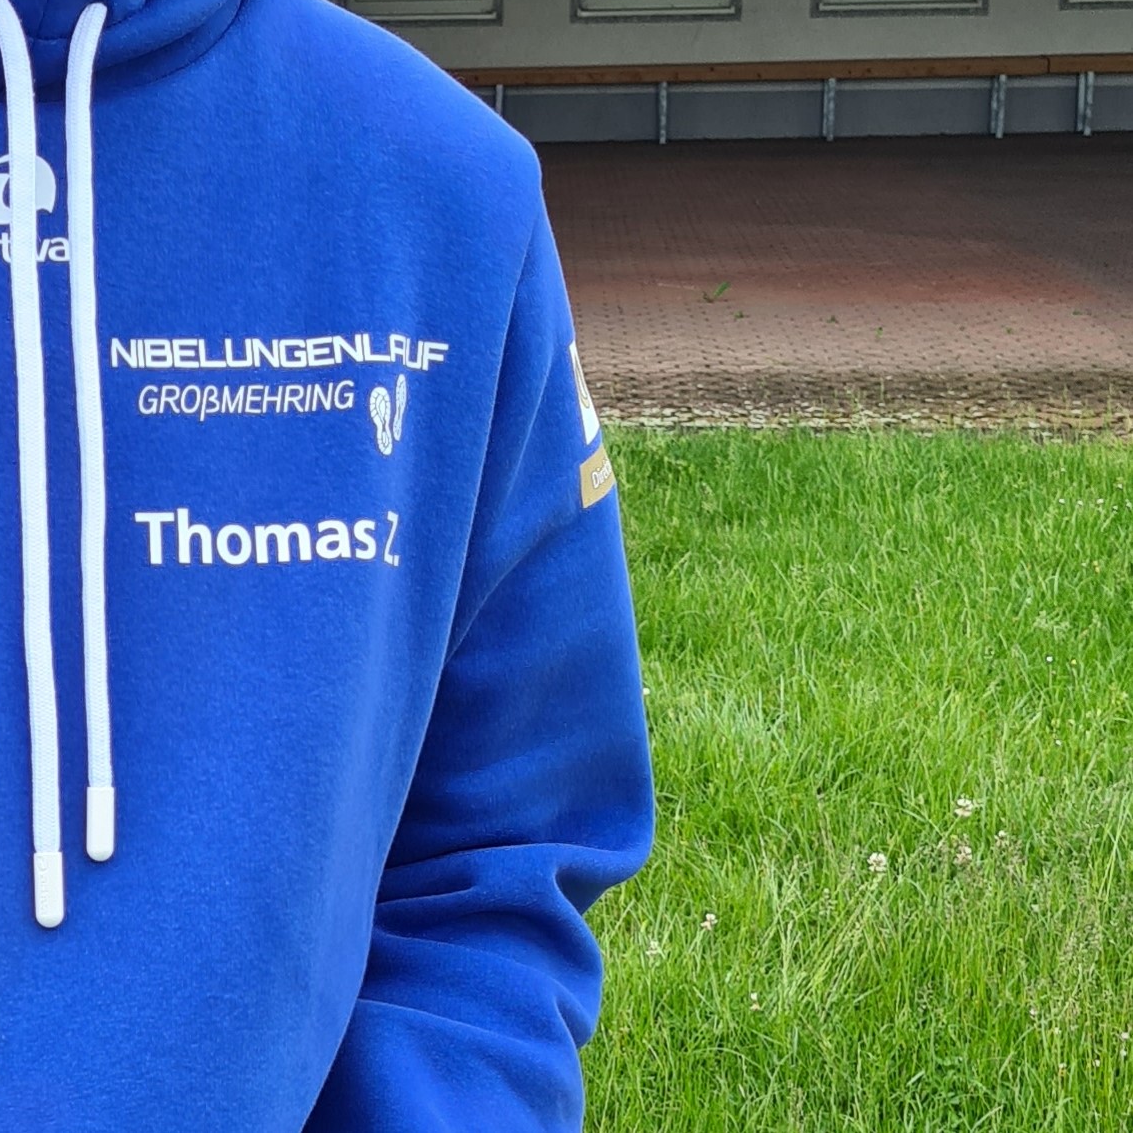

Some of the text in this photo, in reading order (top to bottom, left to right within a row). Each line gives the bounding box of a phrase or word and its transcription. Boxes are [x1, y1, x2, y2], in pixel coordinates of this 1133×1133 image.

[110, 333, 449, 371] NIBELUNGENLAUF
[138, 379, 355, 422] GROßMEHRING
[134, 508, 377, 565] Thomas
